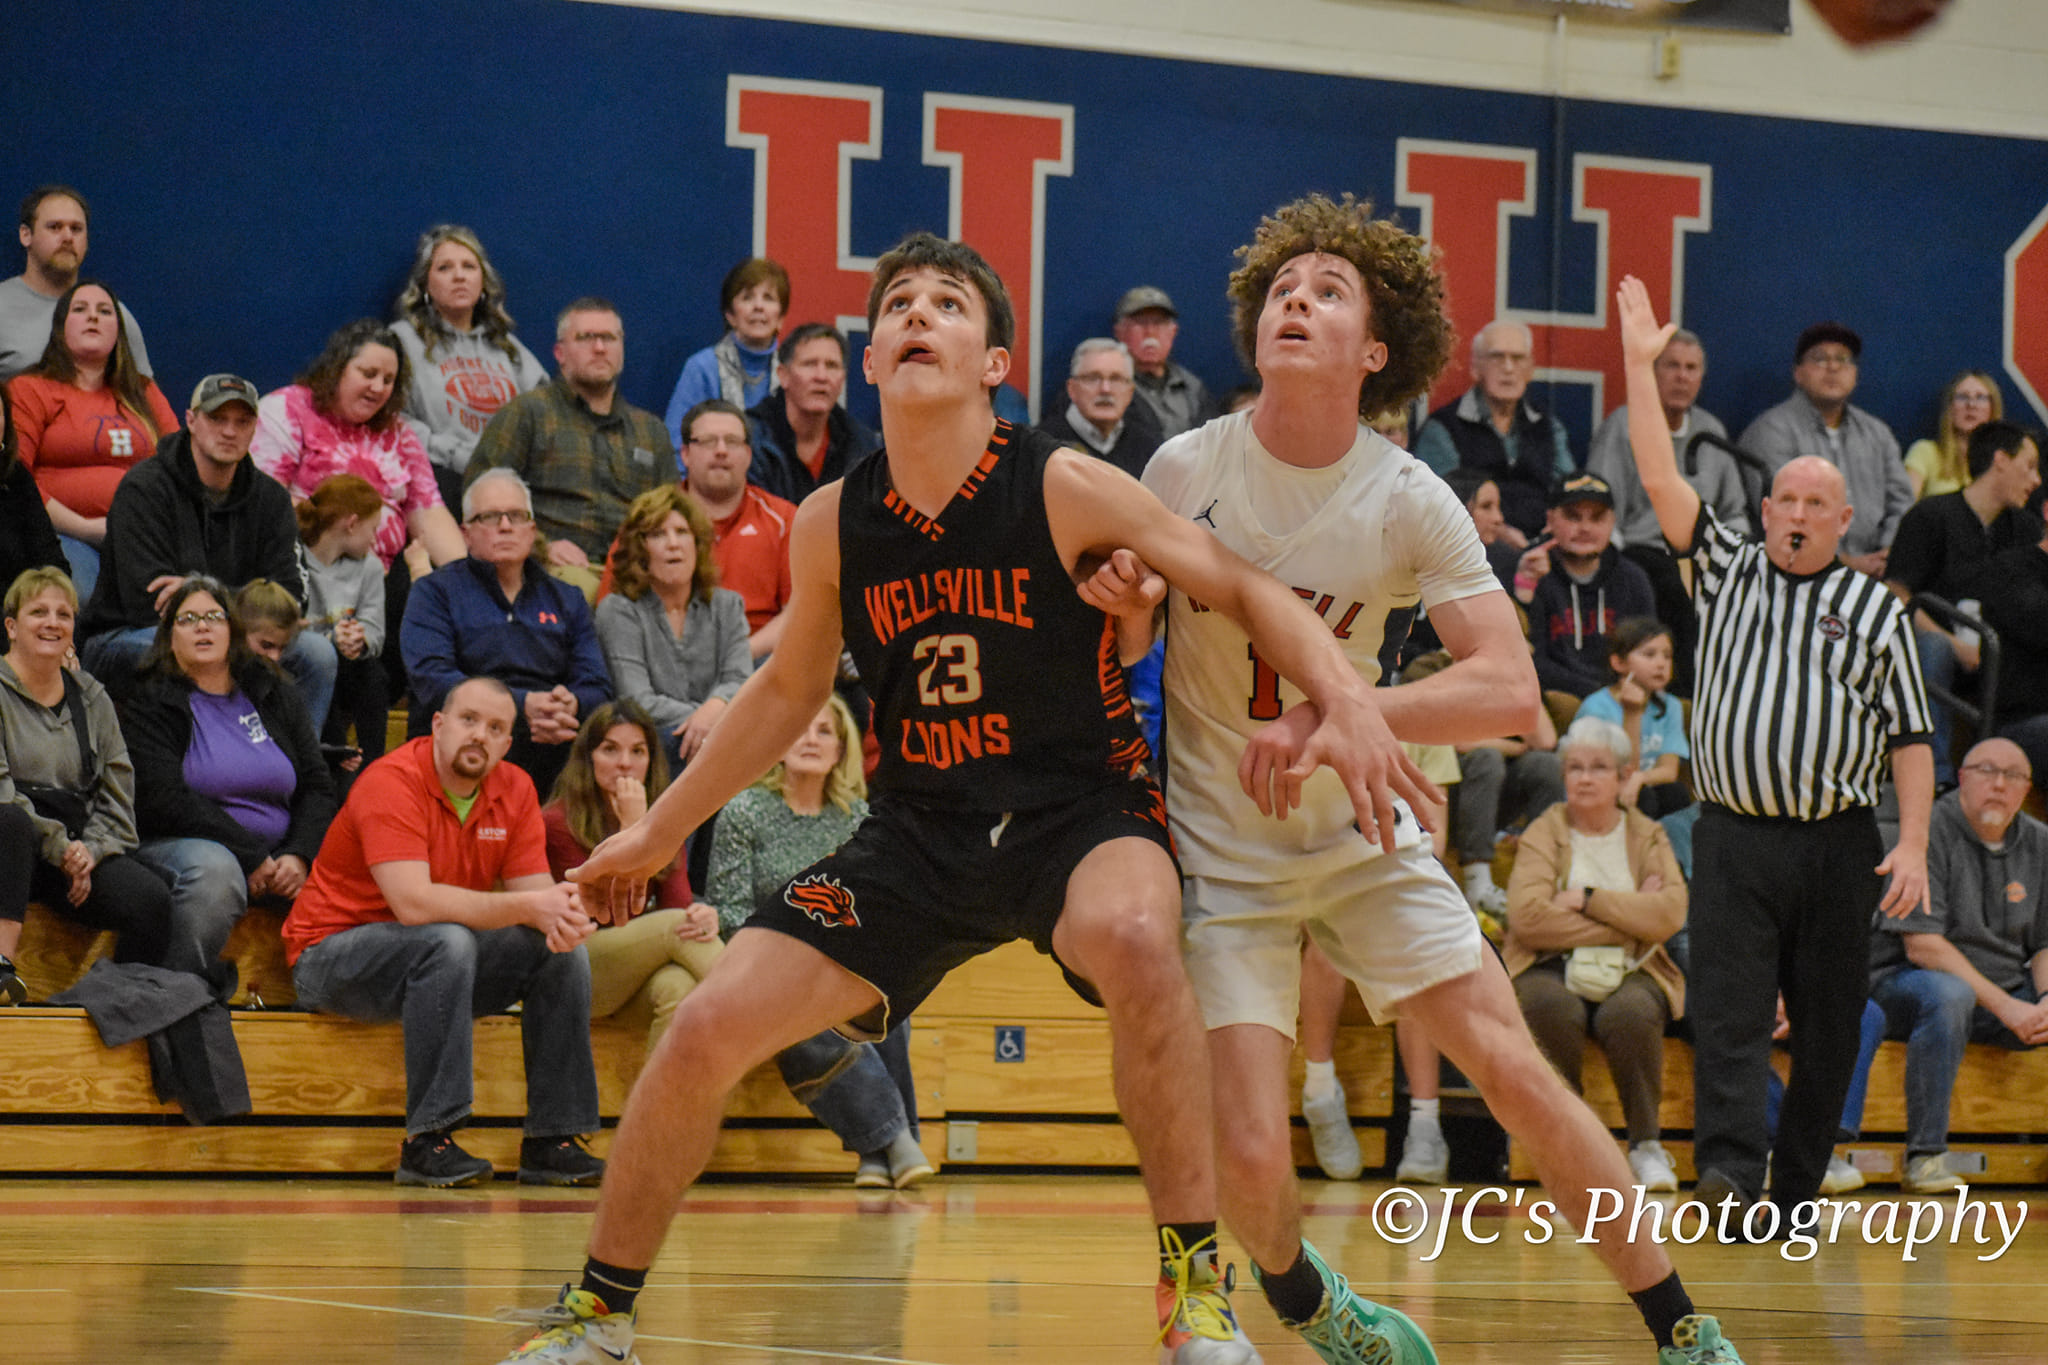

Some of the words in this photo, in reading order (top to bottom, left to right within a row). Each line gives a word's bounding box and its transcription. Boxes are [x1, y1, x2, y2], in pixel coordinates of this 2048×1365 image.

[108, 429, 133, 456] H
[864, 567, 1034, 646] WELLSVILLE
[912, 633, 982, 706] 23
[901, 713, 1011, 770] LIONS
